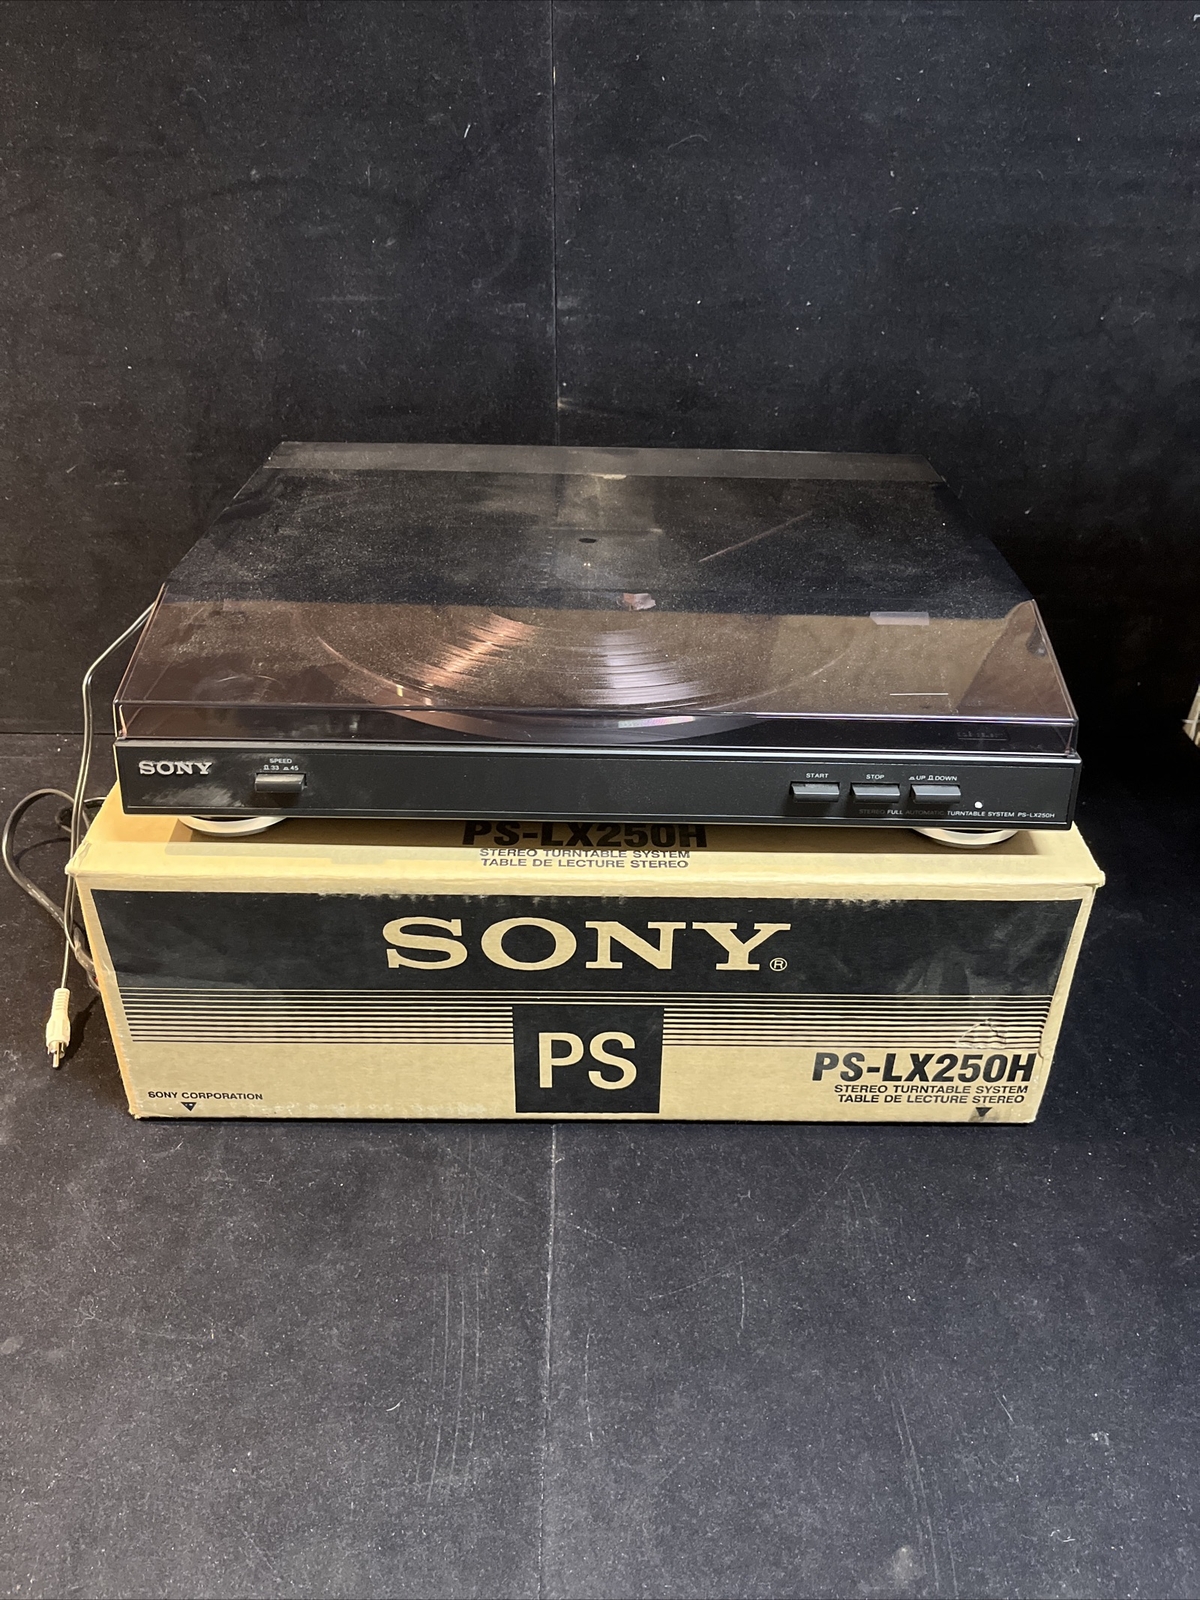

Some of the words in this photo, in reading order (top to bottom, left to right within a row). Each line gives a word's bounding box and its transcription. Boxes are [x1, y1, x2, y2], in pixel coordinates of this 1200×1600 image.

[138, 760, 213, 775] SONY
[462, 820, 708, 849] PS-LX250H
[479, 848, 537, 857] STEREO
[543, 849, 627, 858] TURNTABLE
[632, 850, 691, 859] SYSTEM
[481, 858, 527, 867] TABLE
[532, 858, 552, 867] DE
[558, 859, 625, 868] LECTURE
[630, 859, 688, 869] STEREO
[538, 1031, 638, 1090] PS
[811, 1052, 1037, 1083] PS-LX250H
[834, 1084, 888, 1093] STEREO
[893, 1085, 971, 1094] TURNTABLE
[976, 1085, 1028, 1094] SYSTEM
[148, 1091, 178, 1099] SONY
[181, 1092, 263, 1100] CORPORATION
[837, 1094, 880, 1103] TABLE
[884, 1094, 902, 1103] DE
[907, 1094, 968, 1104] LECTURE
[972, 1095, 1025, 1104] STEREO
